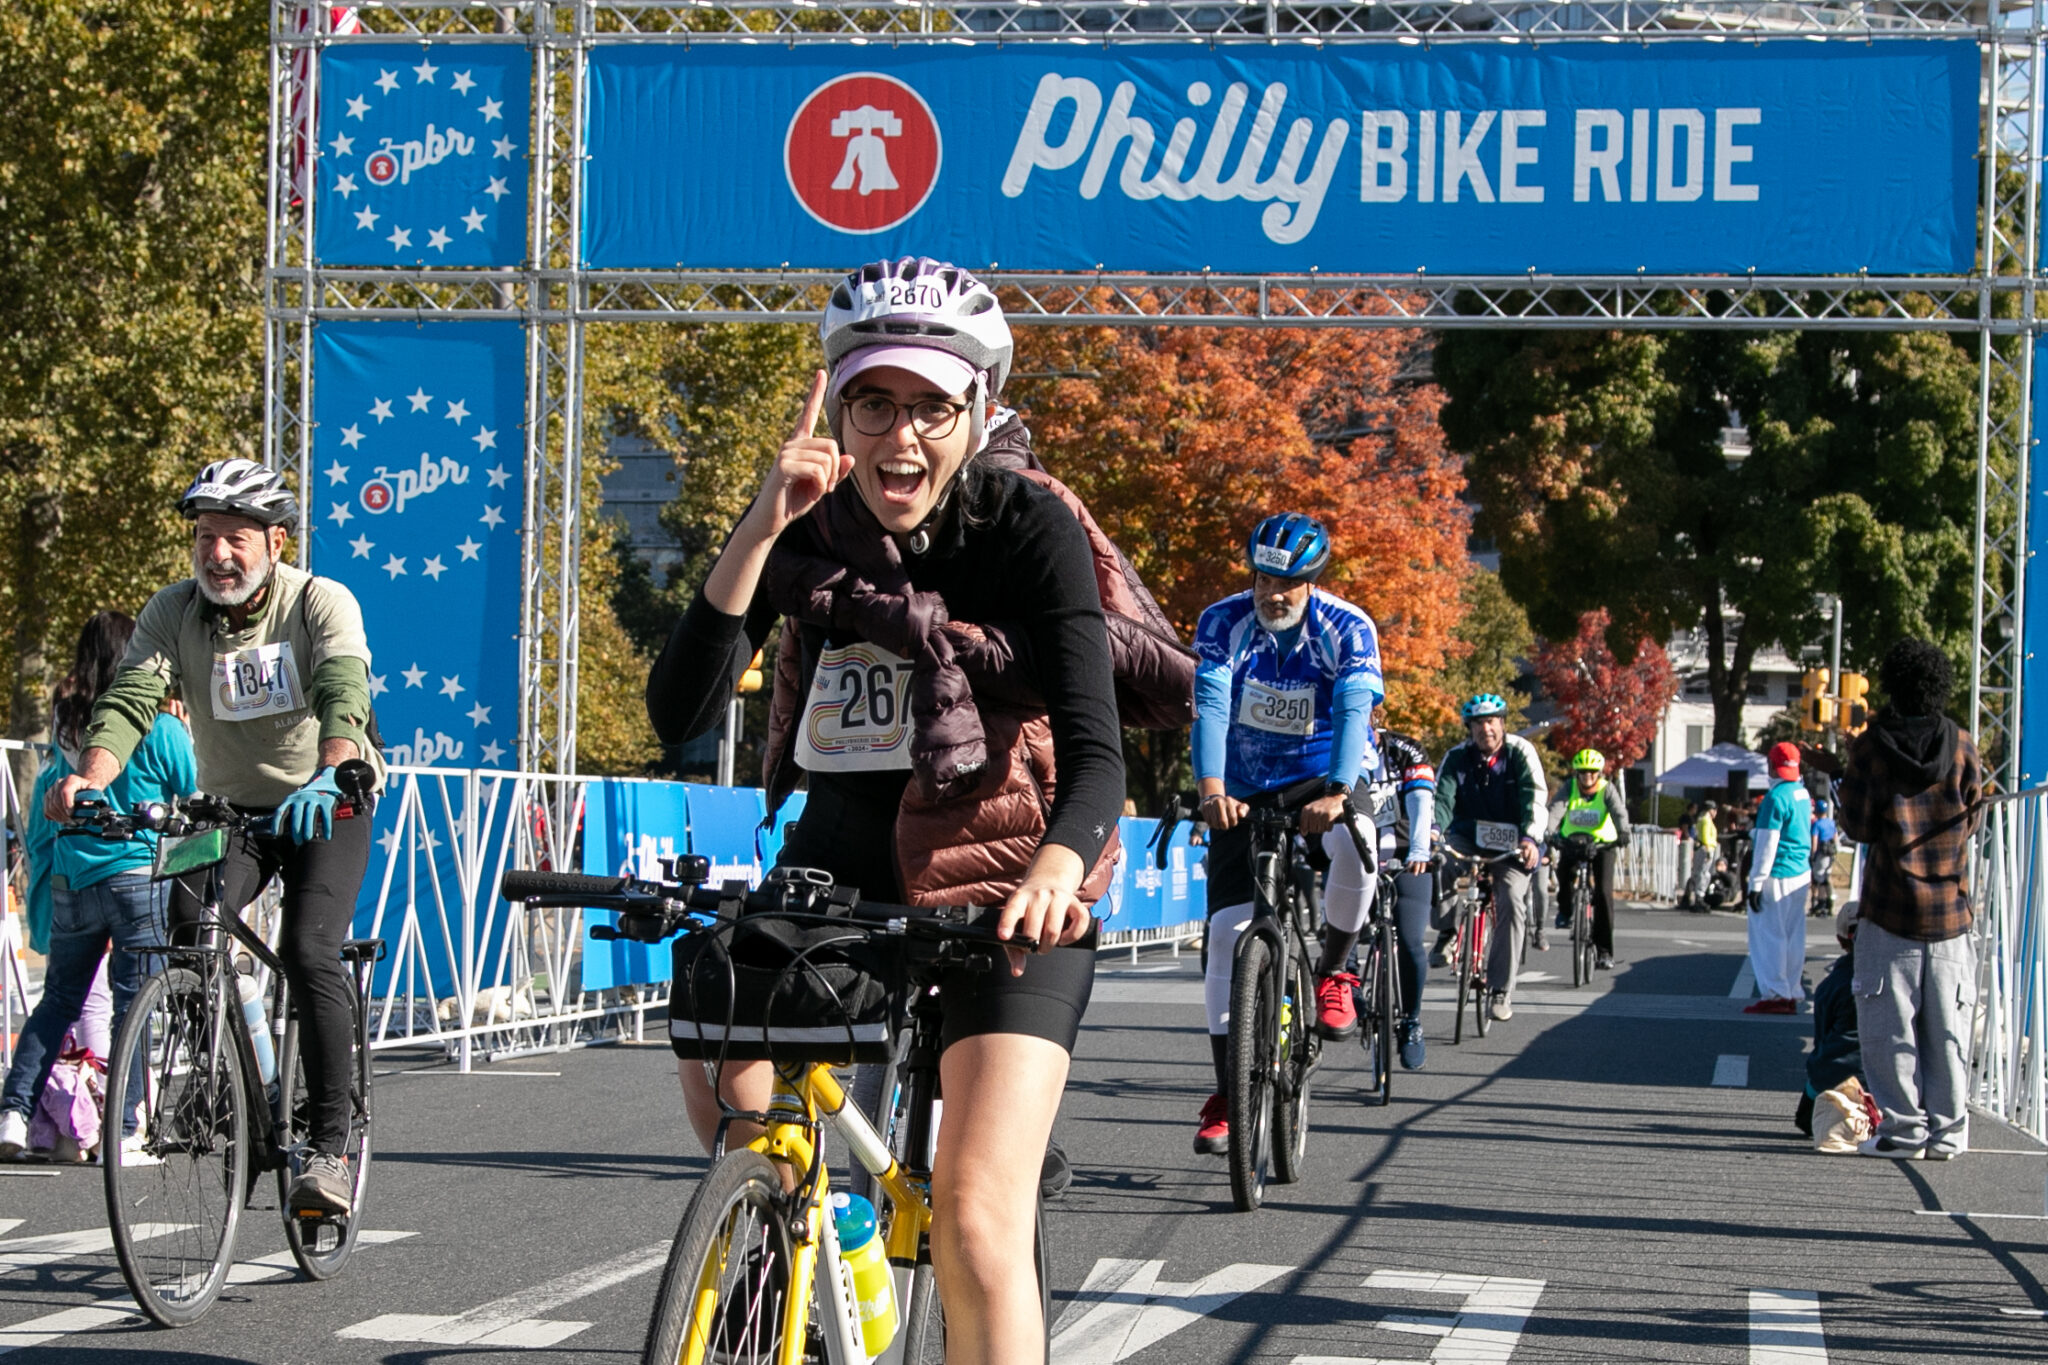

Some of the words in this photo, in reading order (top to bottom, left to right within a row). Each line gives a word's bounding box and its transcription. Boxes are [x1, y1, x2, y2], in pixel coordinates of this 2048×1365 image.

[401, 123, 475, 185] pbr
[1001, 72, 1350, 245] Philly
[1360, 109, 1547, 203] BIKE
[1574, 107, 1762, 202] RIDE
[890, 284, 943, 309] 2670
[396, 451, 470, 514] pbr
[232, 656, 285, 697] 1347
[1264, 695, 1310, 721] 3250
